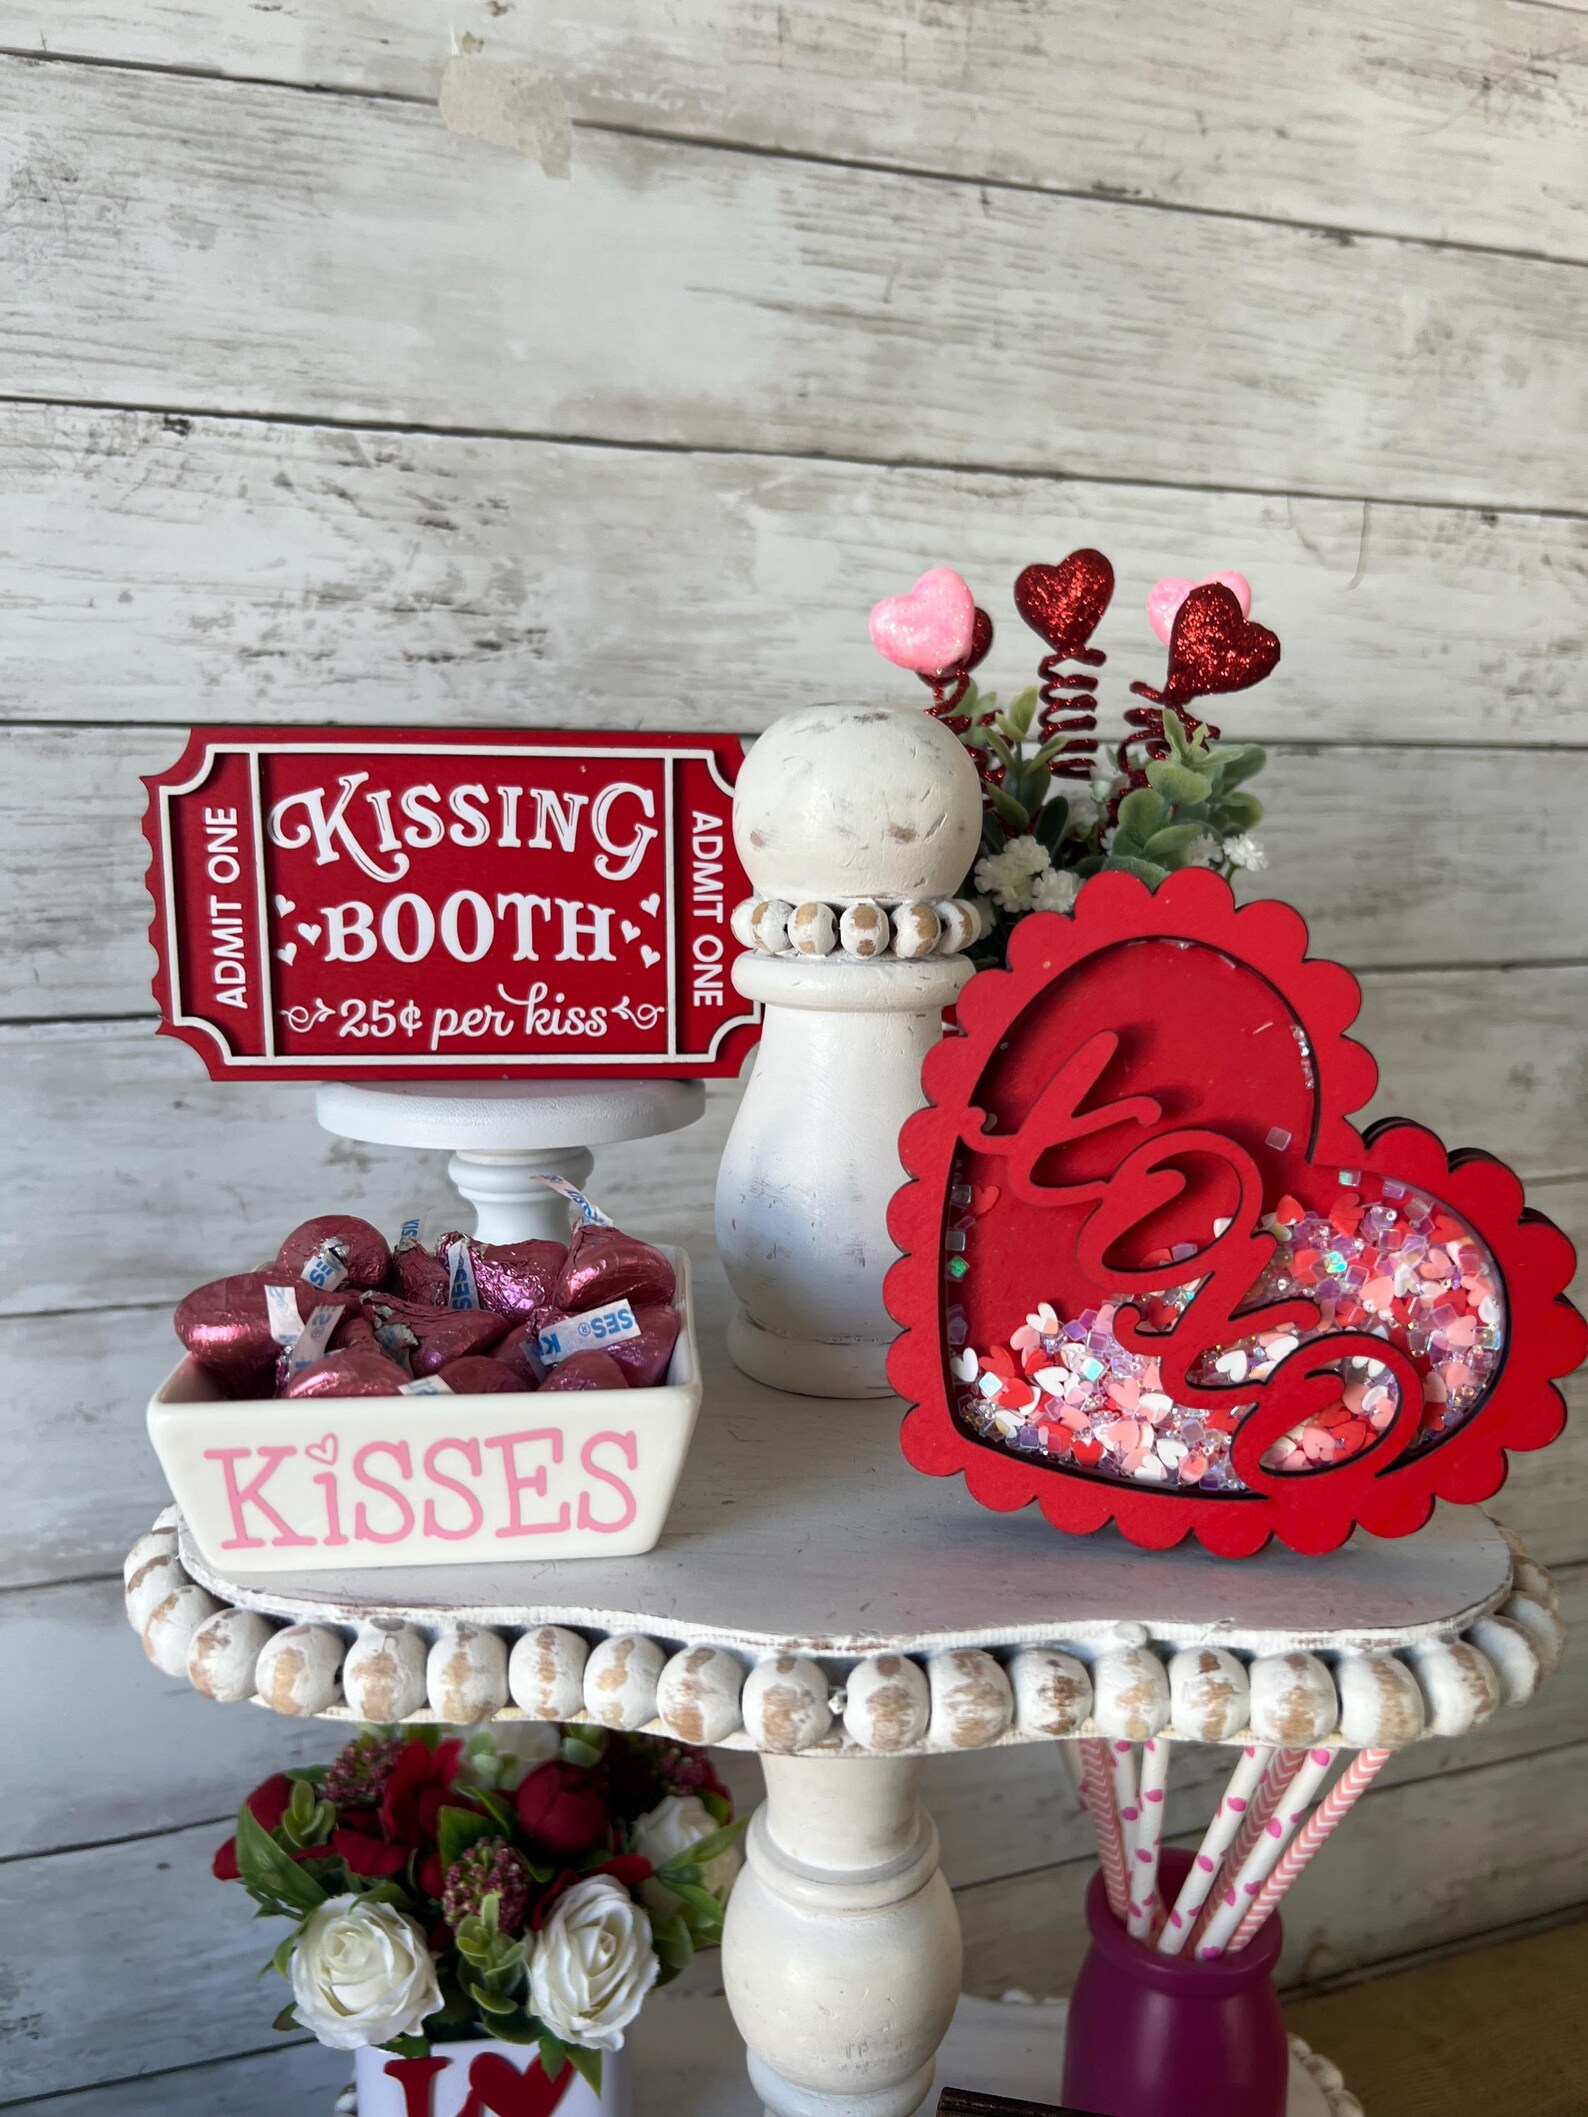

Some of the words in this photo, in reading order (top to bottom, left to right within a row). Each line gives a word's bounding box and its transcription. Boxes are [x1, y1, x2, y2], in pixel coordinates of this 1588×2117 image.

[204, 806, 240, 885] ONE
[691, 809, 725, 924] ADMIT
[211, 896, 248, 1010] ADMIT
[321, 889, 617, 964] BOOTH
[692, 934, 725, 1008] ONE
[339, 999, 423, 1039] 25¢
[430, 1007, 513, 1051] per
[498, 982, 609, 1037] kiss
